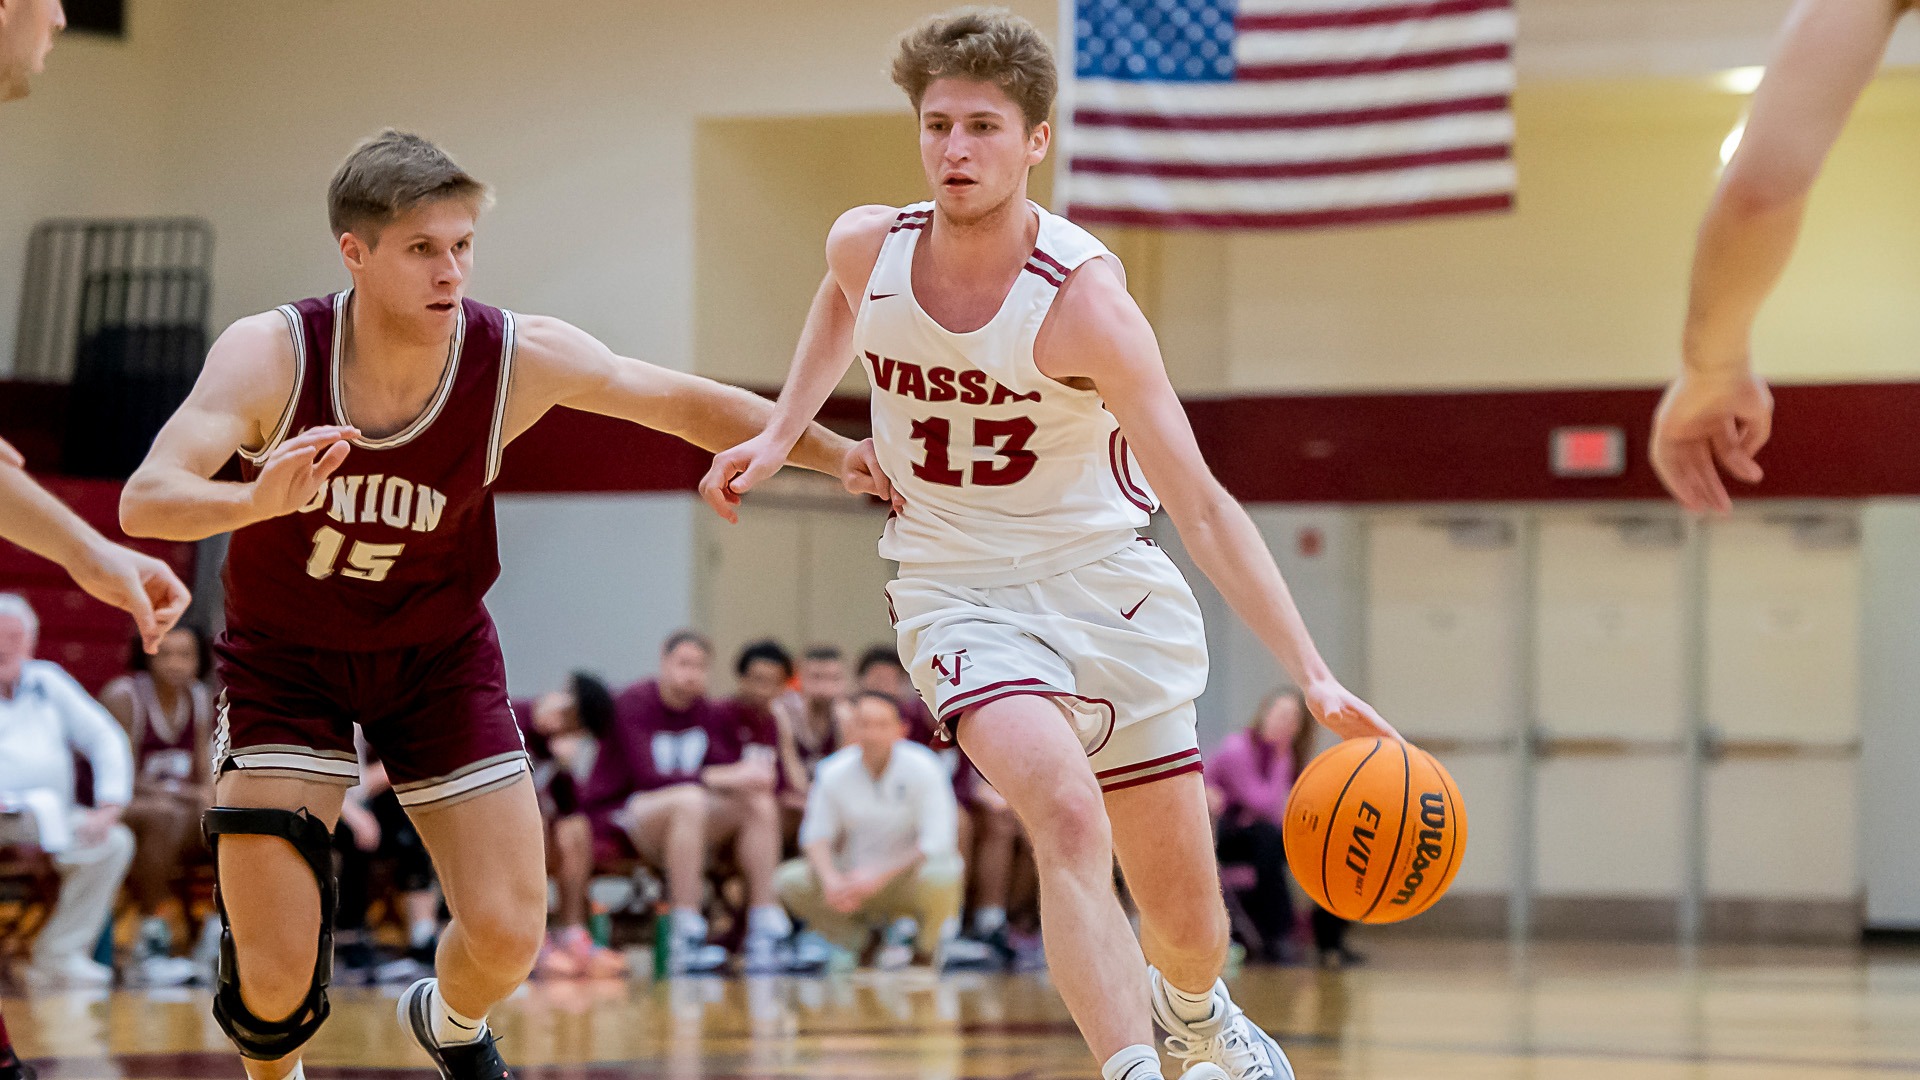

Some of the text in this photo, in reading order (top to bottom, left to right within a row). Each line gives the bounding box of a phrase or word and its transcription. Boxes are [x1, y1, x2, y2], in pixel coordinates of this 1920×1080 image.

[909, 415, 1040, 488] 13
[306, 524, 406, 582] 15
[1345, 801, 1382, 877] EVO
[1390, 791, 1446, 906] Wilson
